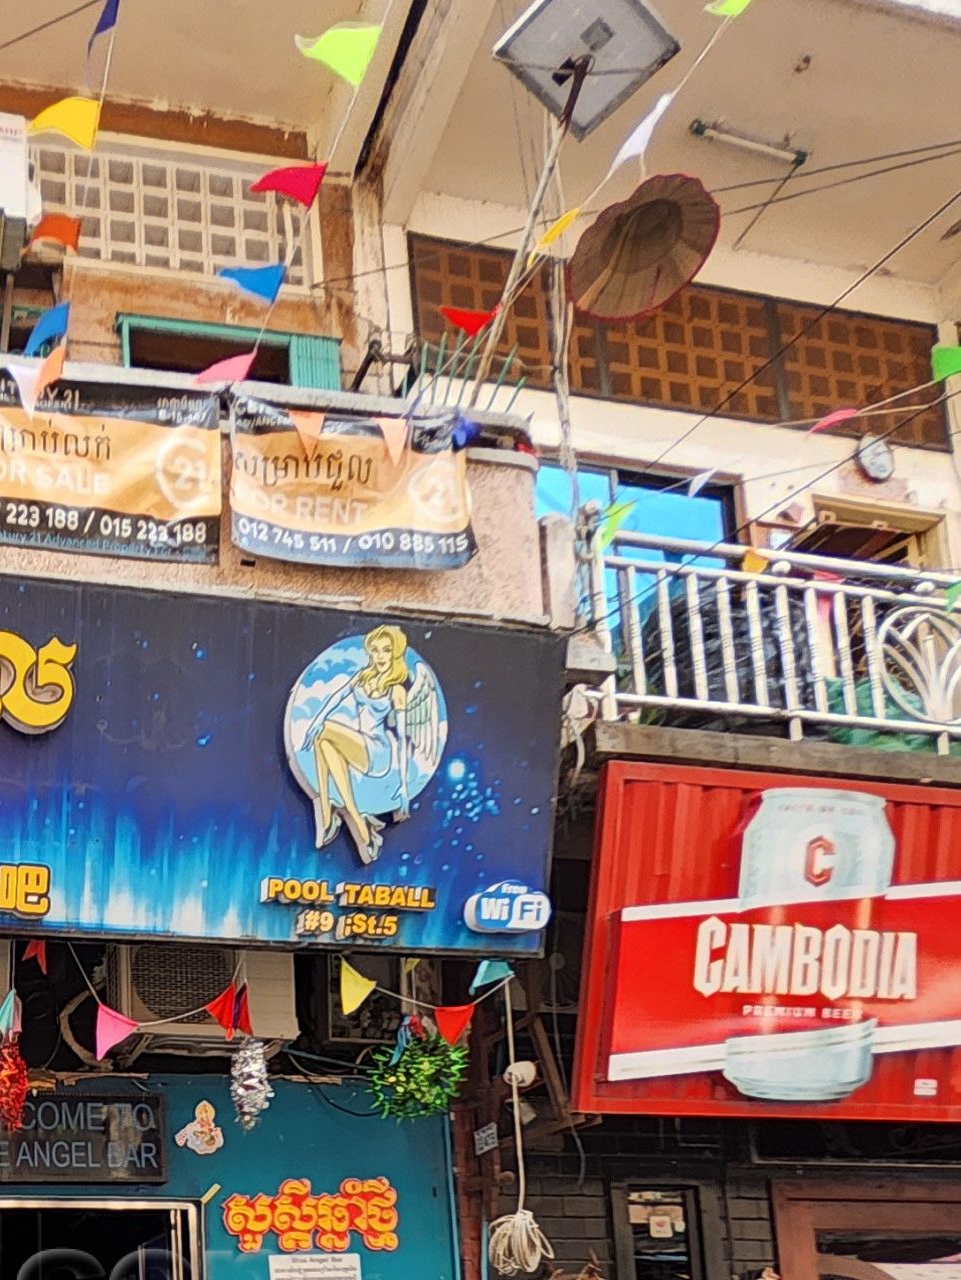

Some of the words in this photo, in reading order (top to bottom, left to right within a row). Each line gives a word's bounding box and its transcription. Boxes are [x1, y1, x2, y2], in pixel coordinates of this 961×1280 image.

[33, 460, 112, 496] SALE
[5, 502, 40, 528] 223
[45, 507, 80, 532] 188
[99, 514, 133, 538] 015
[173, 522, 207, 545] 188
[295, 494, 369, 527] RENT
[237, 517, 269, 542] 012
[358, 531, 395, 552] 010
[399, 533, 435, 553] 885
[437, 533, 469, 553] 115
[805, 835, 837, 888] C
[267, 877, 335, 902] POOL
[342, 882, 436, 910] TABALL
[303, 909, 335, 932] #9
[693, 915, 918, 1001] CAMBODIA
[16, 1140, 101, 1169] ANGEL
[107, 1142, 159, 1169] BAR
